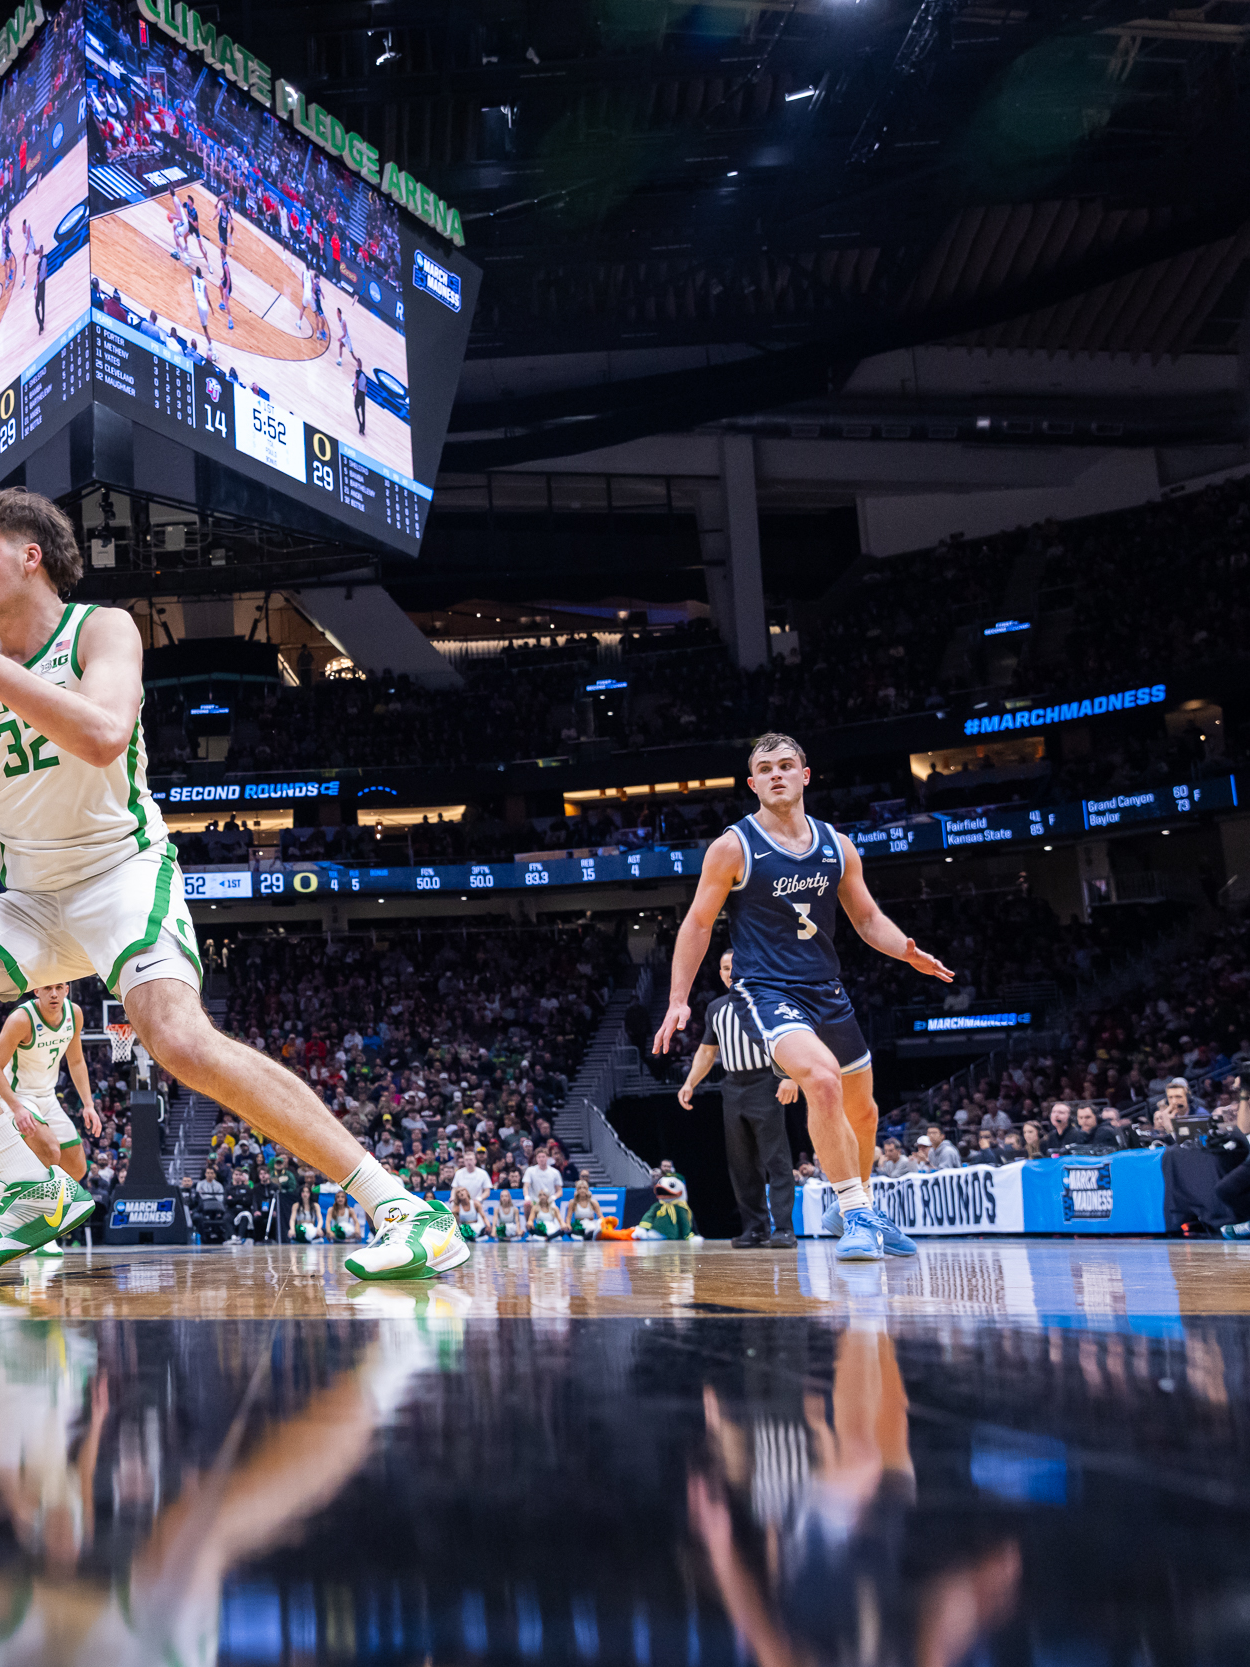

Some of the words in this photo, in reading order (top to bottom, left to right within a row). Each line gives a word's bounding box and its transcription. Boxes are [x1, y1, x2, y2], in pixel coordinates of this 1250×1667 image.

[138, 0, 271, 107] CLIMATE
[276, 79, 379, 183] PLEDGE
[381, 161, 465, 246] ARENA
[423, 258, 449, 284] MARCH
[427, 275, 460, 307] MADNESS
[104, 329, 125, 347] PORTER
[104, 340, 129, 359] METHENY
[96, 348, 102, 357] 11
[104, 352, 121, 367] YATES
[104, 363, 135, 385] CLEVELAND
[104, 375, 136, 397] MAUGHMER
[0, 389, 15, 420] O
[204, 403, 228, 438] 14
[253, 408, 286, 445] 5:52
[0, 417, 16, 454] 29
[313, 432, 332, 461] O
[312, 460, 334, 491] 29
[964, 684, 1166, 735] #MARCHMADNESS
[169, 785, 240, 802] SECOND
[244, 782, 319, 798] ROUNDS
[1088, 798, 1116, 813] Grand
[1117, 793, 1154, 807] Canyon
[1173, 784, 1189, 798] 60
[1193, 788, 1201, 802] F
[946, 817, 987, 832] Fairfield
[1029, 810, 1041, 822] 41
[1048, 813, 1056, 825] F
[1089, 812, 1121, 827] Baylor
[1175, 799, 1191, 812] 73
[857, 830, 887, 843] Austin
[890, 827, 904, 839] 54
[908, 831, 915, 843] F
[947, 832, 984, 846] Kansas
[984, 828, 1012, 842] State
[421, 868, 434, 876] FG%
[581, 858, 595, 867] REB
[627, 855, 641, 864] AST
[670, 852, 684, 861] STL
[184, 877, 206, 895] 52
[227, 879, 241, 888] 1ST
[260, 873, 284, 893] 29
[293, 872, 318, 893] O
[330, 880, 338, 891] 4
[352, 879, 360, 891] 5
[416, 877, 440, 889] 50.0
[470, 875, 494, 888] 50.0
[525, 872, 549, 885] 83.3
[582, 868, 595, 881] 15
[631, 864, 640, 877] 4
[673, 861, 683, 874] 4
[772, 872, 829, 897] Liberty
[792, 903, 817, 940] 3
[928, 1012, 1017, 1031] MARCHMADNESS
[38, 1036, 72, 1048] DUCKS
[1069, 1169, 1099, 1190] MARCH
[125, 1201, 158, 1212] MARCH
[873, 1177, 917, 1227] ECOND
[920, 1171, 997, 1227] ROUNDS
[1072, 1190, 1113, 1211] MADNESS
[129, 1211, 173, 1222] MADNESS
